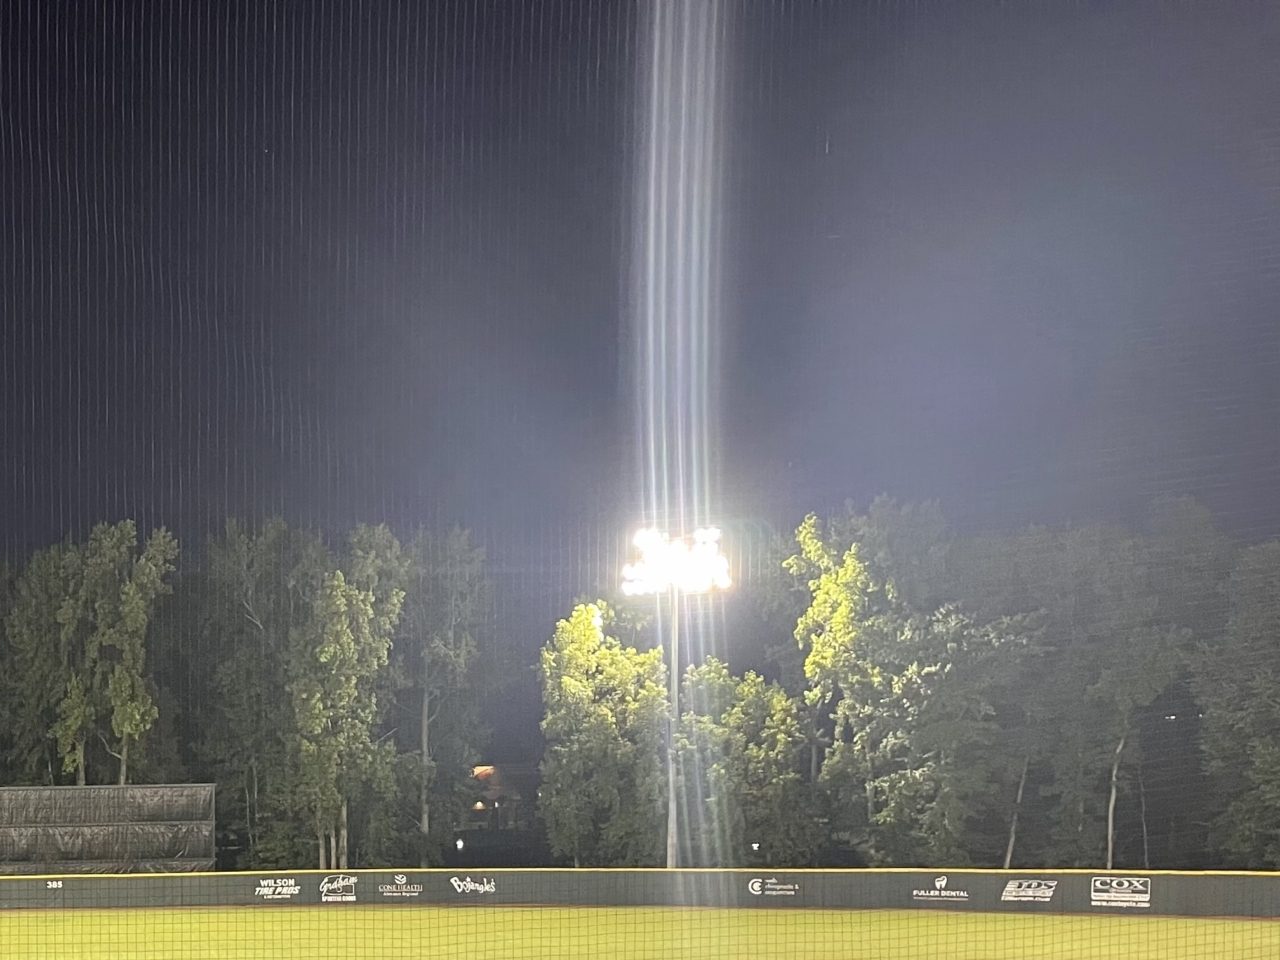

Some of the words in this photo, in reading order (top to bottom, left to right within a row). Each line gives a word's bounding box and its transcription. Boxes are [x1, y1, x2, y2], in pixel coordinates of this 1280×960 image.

[46, 880, 63, 889] 385
[260, 878, 295, 887] WILSON
[1095, 879, 1147, 890] COX
[254, 886, 275, 896] TIRE
[274, 885, 301, 895] PROS
